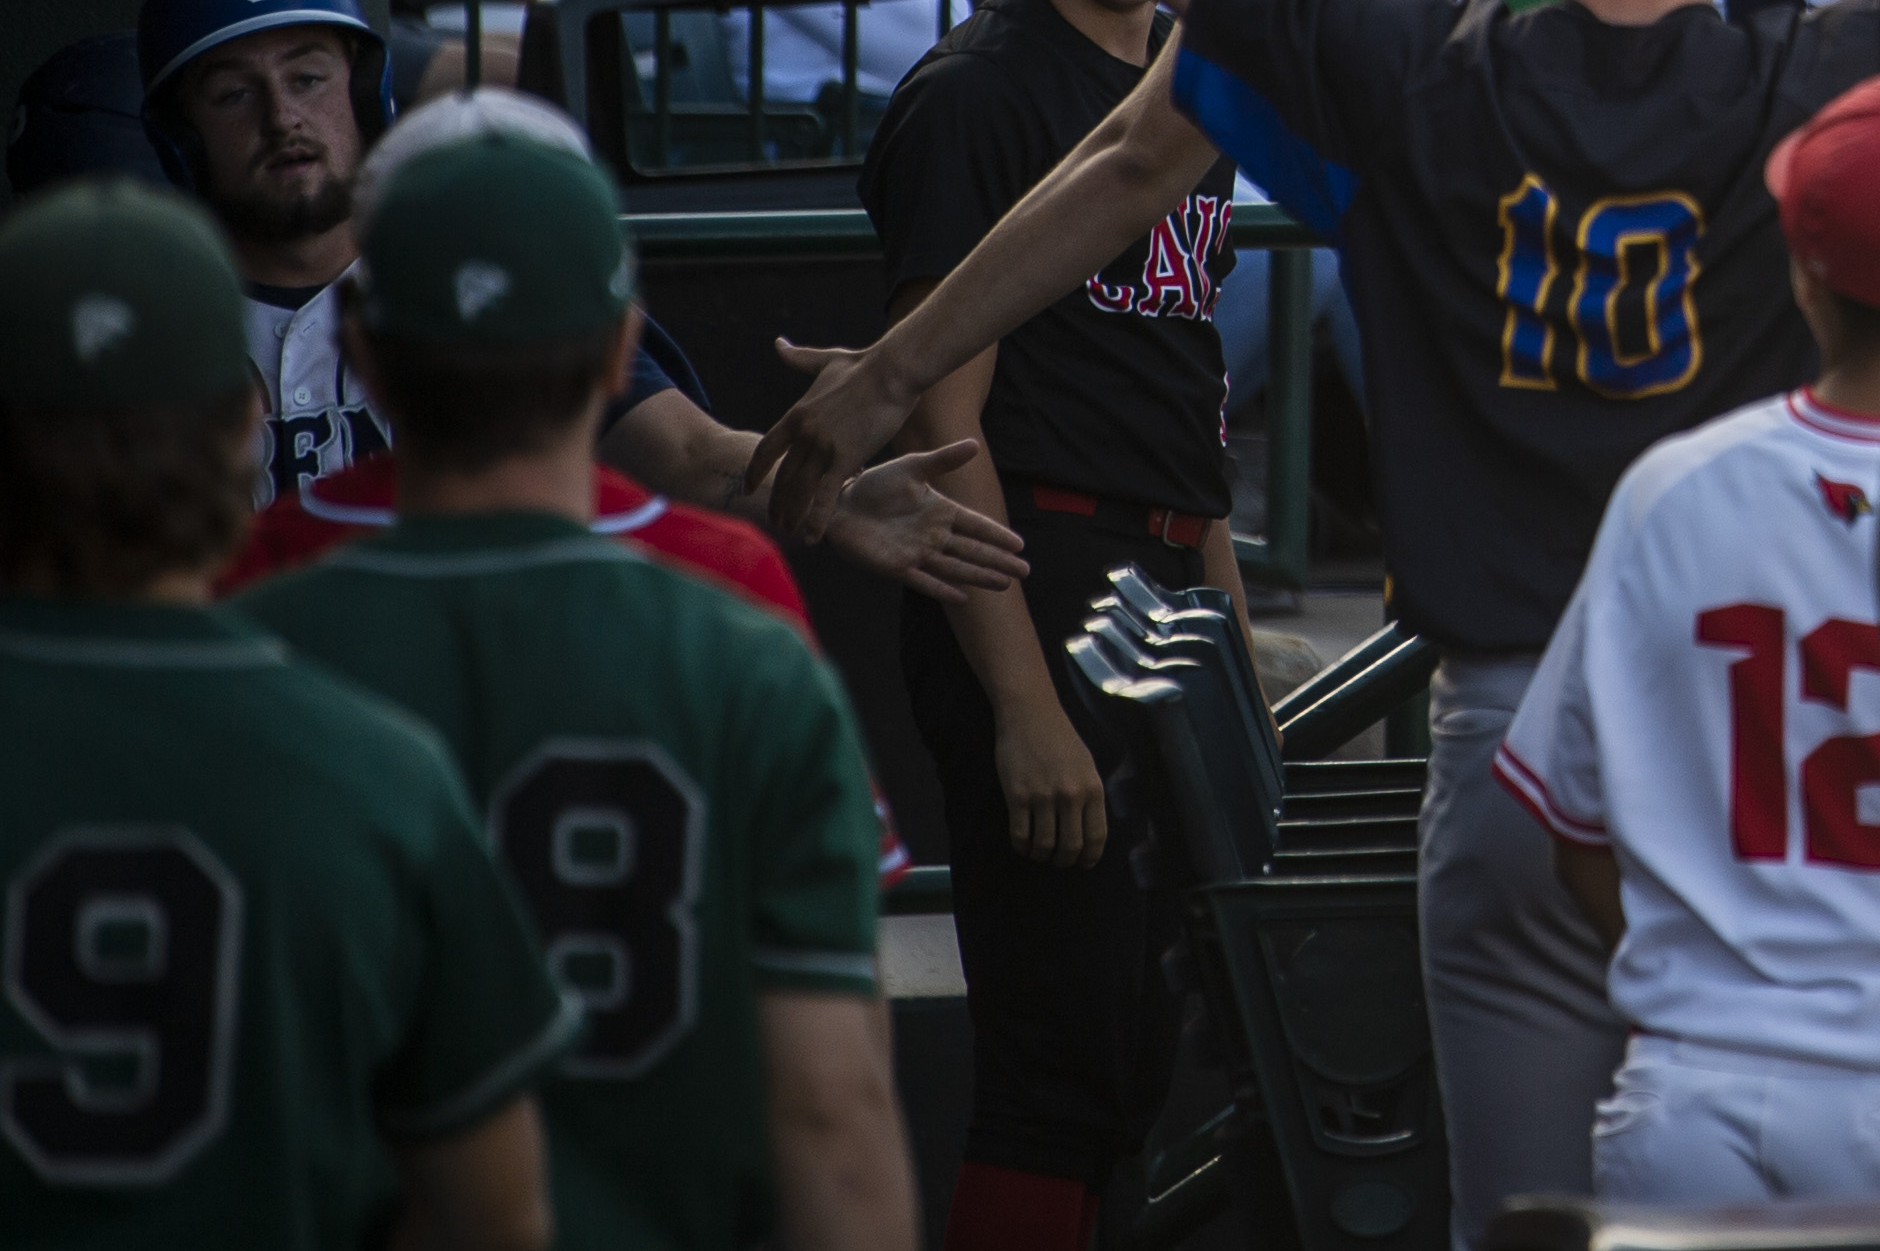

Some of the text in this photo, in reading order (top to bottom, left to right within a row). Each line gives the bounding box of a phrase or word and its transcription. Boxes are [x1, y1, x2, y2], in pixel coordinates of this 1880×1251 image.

[1497, 172, 1708, 400] 10
[0, 822, 245, 1186] 9
[488, 737, 706, 1079] 8
